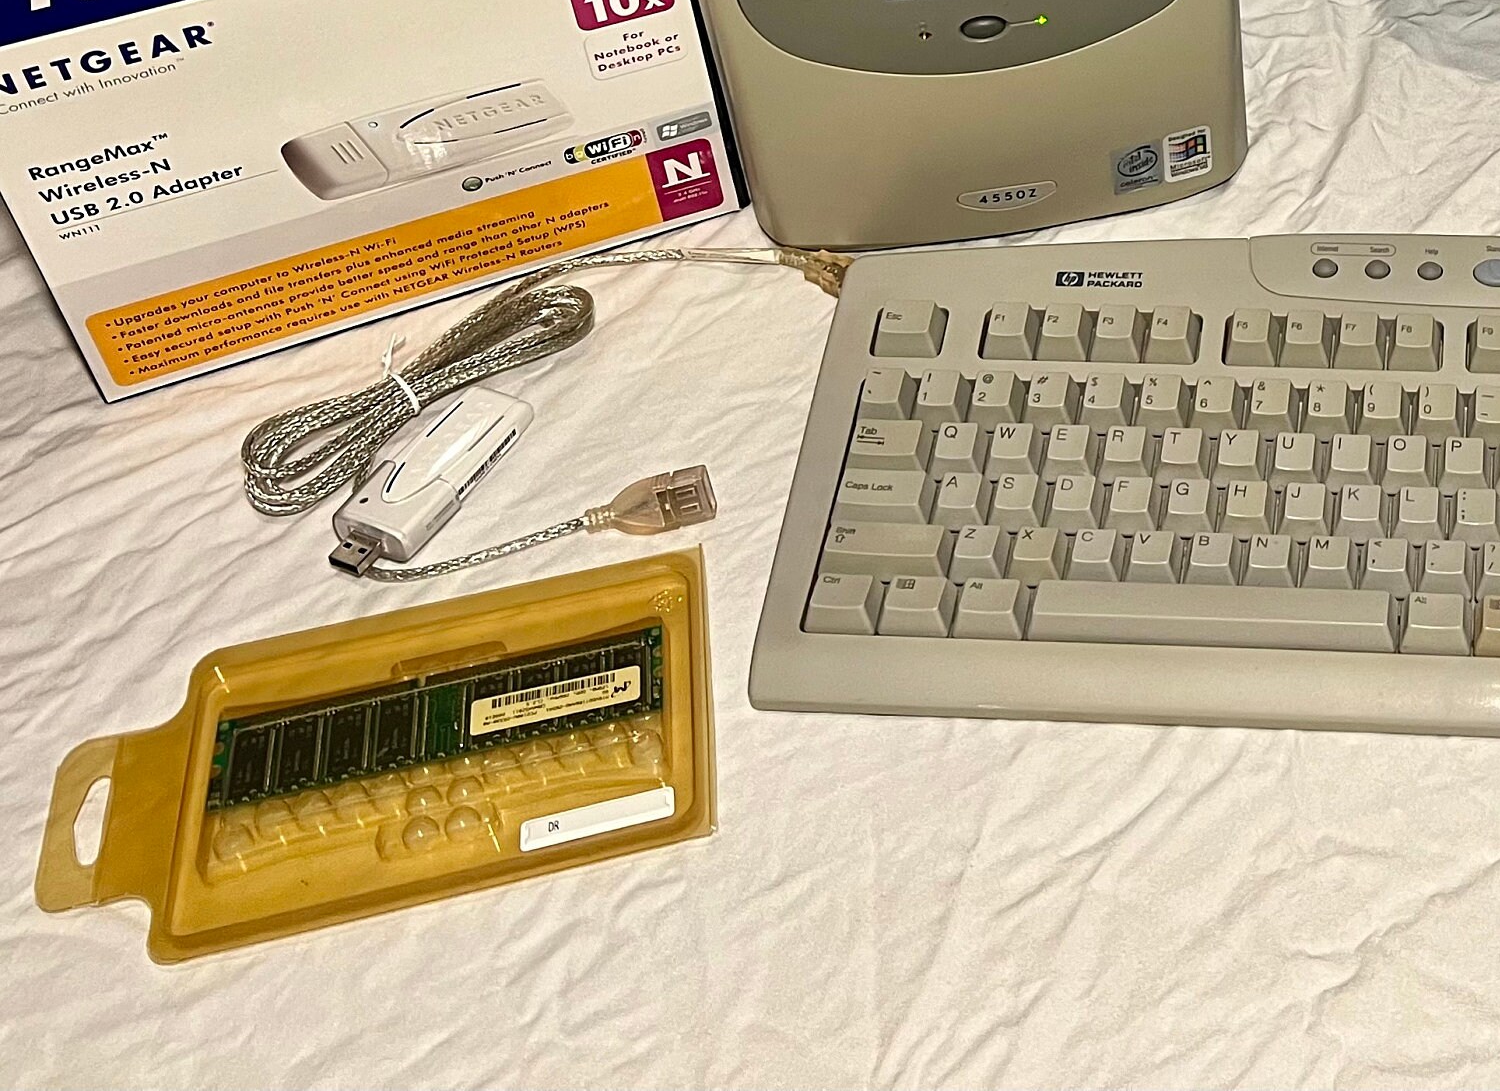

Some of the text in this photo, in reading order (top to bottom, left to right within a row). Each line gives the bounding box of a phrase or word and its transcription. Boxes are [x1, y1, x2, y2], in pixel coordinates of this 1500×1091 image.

[623, 31, 644, 42] For
[594, 33, 680, 61] Notebook or
[598, 45, 681, 72] Desktop PCs
[63, 82, 95, 98] with
[433, 94, 545, 131] NETGEAR
[663, 152, 705, 188] N
[38, 158, 172, 203] Wireless-N
[50, 166, 243, 225] USB 2.0 Adapter
[59, 224, 101, 240] WN111
[119, 210, 535, 338] Faster downloads and file transfers plus enhanced media streaming
[126, 200, 610, 351] Patented micro-antennas provide better speed and range than other adapters
[1088, 271, 1144, 280] HEWLETT
[114, 236, 396, 327] Upgrades your computer to Wireless-N Wi-Fi
[1087, 280, 1144, 288] PACKARD
[132, 348, 160, 363] Easy
[164, 331, 214, 353] secured
[217, 321, 252, 338] setup
[255, 311, 282, 325] with
[285, 302, 314, 316] Push
[341, 278, 390, 299] Connect
[394, 267, 427, 284] using
[459, 240, 513, 263] Protected
[517, 230, 549, 247] Setup
[553, 219, 586, 236] (WPS)
[138, 239, 563, 374] Maximum performance requires use with NETGEAR Wireless-N Routers
[886, 312, 903, 321] Esc
[860, 426, 878, 435] Tab
[944, 425, 958, 439] Q
[1000, 426, 1016, 439] W
[1056, 428, 1068, 441] E
[1112, 430, 1124, 443] R
[1169, 432, 1181, 444] T
[1225, 433, 1237, 445] Y
[1282, 437, 1295, 449] U
[1393, 438, 1407, 451] O
[1451, 440, 1463, 452] P
[845, 481, 893, 492] Caps Lock
[946, 476, 959, 488] A
[1003, 477, 1015, 489] S
[1060, 479, 1073, 491] D
[1118, 480, 1130, 493] F
[1176, 482, 1190, 496] G
[1234, 485, 1247, 498] H
[1291, 486, 1301, 499] J
[1348, 487, 1360, 500] K
[1405, 489, 1415, 502] L
[964, 528, 977, 539] Z
[1022, 529, 1035, 540] X
[1081, 531, 1094, 542] C
[1139, 534, 1151, 545] V
[1199, 536, 1210, 546] B
[1256, 537, 1269, 548] N
[1315, 539, 1329, 550] M
[823, 576, 841, 585] Ctrl
